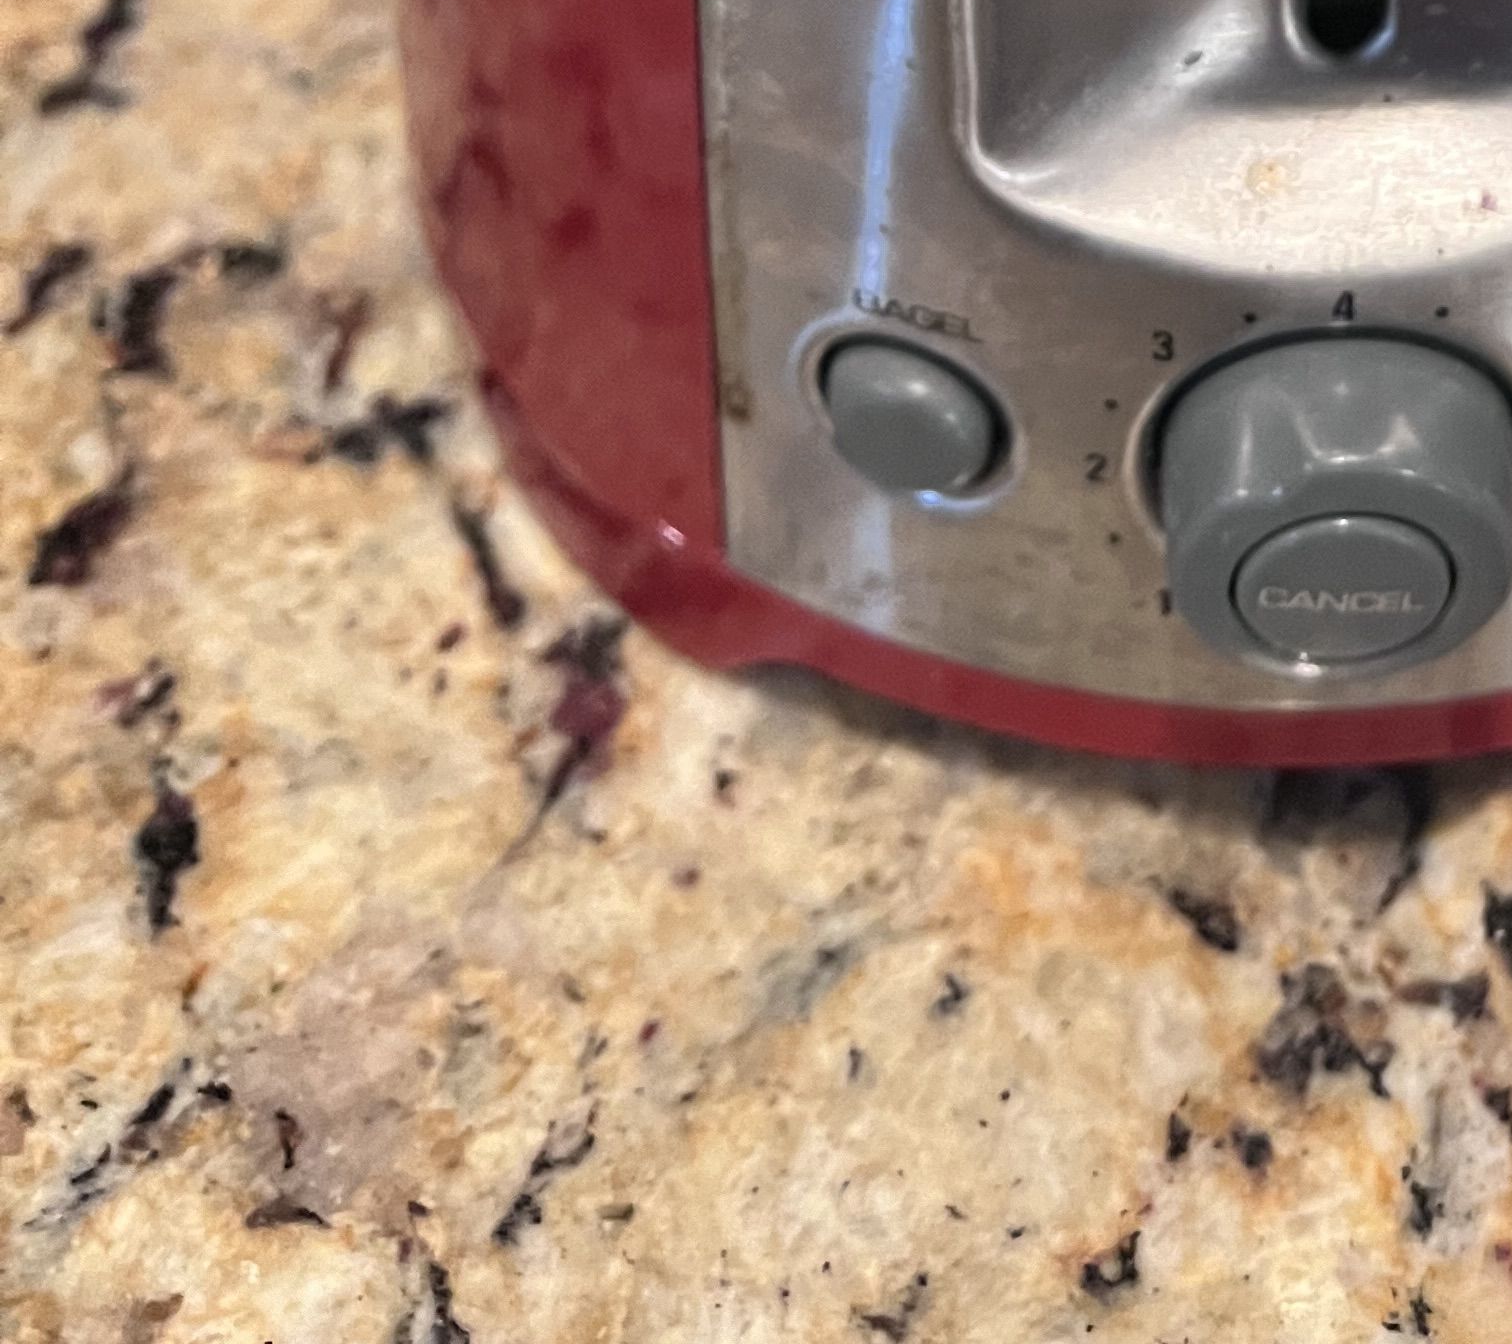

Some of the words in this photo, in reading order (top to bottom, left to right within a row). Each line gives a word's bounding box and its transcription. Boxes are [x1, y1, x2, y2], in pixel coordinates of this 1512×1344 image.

[1332, 290, 1354, 321] 4
[1152, 330, 1174, 362] 3
[1085, 452, 1108, 483] 2
[1158, 588, 1173, 616] 1
[1257, 585, 1426, 613] CANCEL
